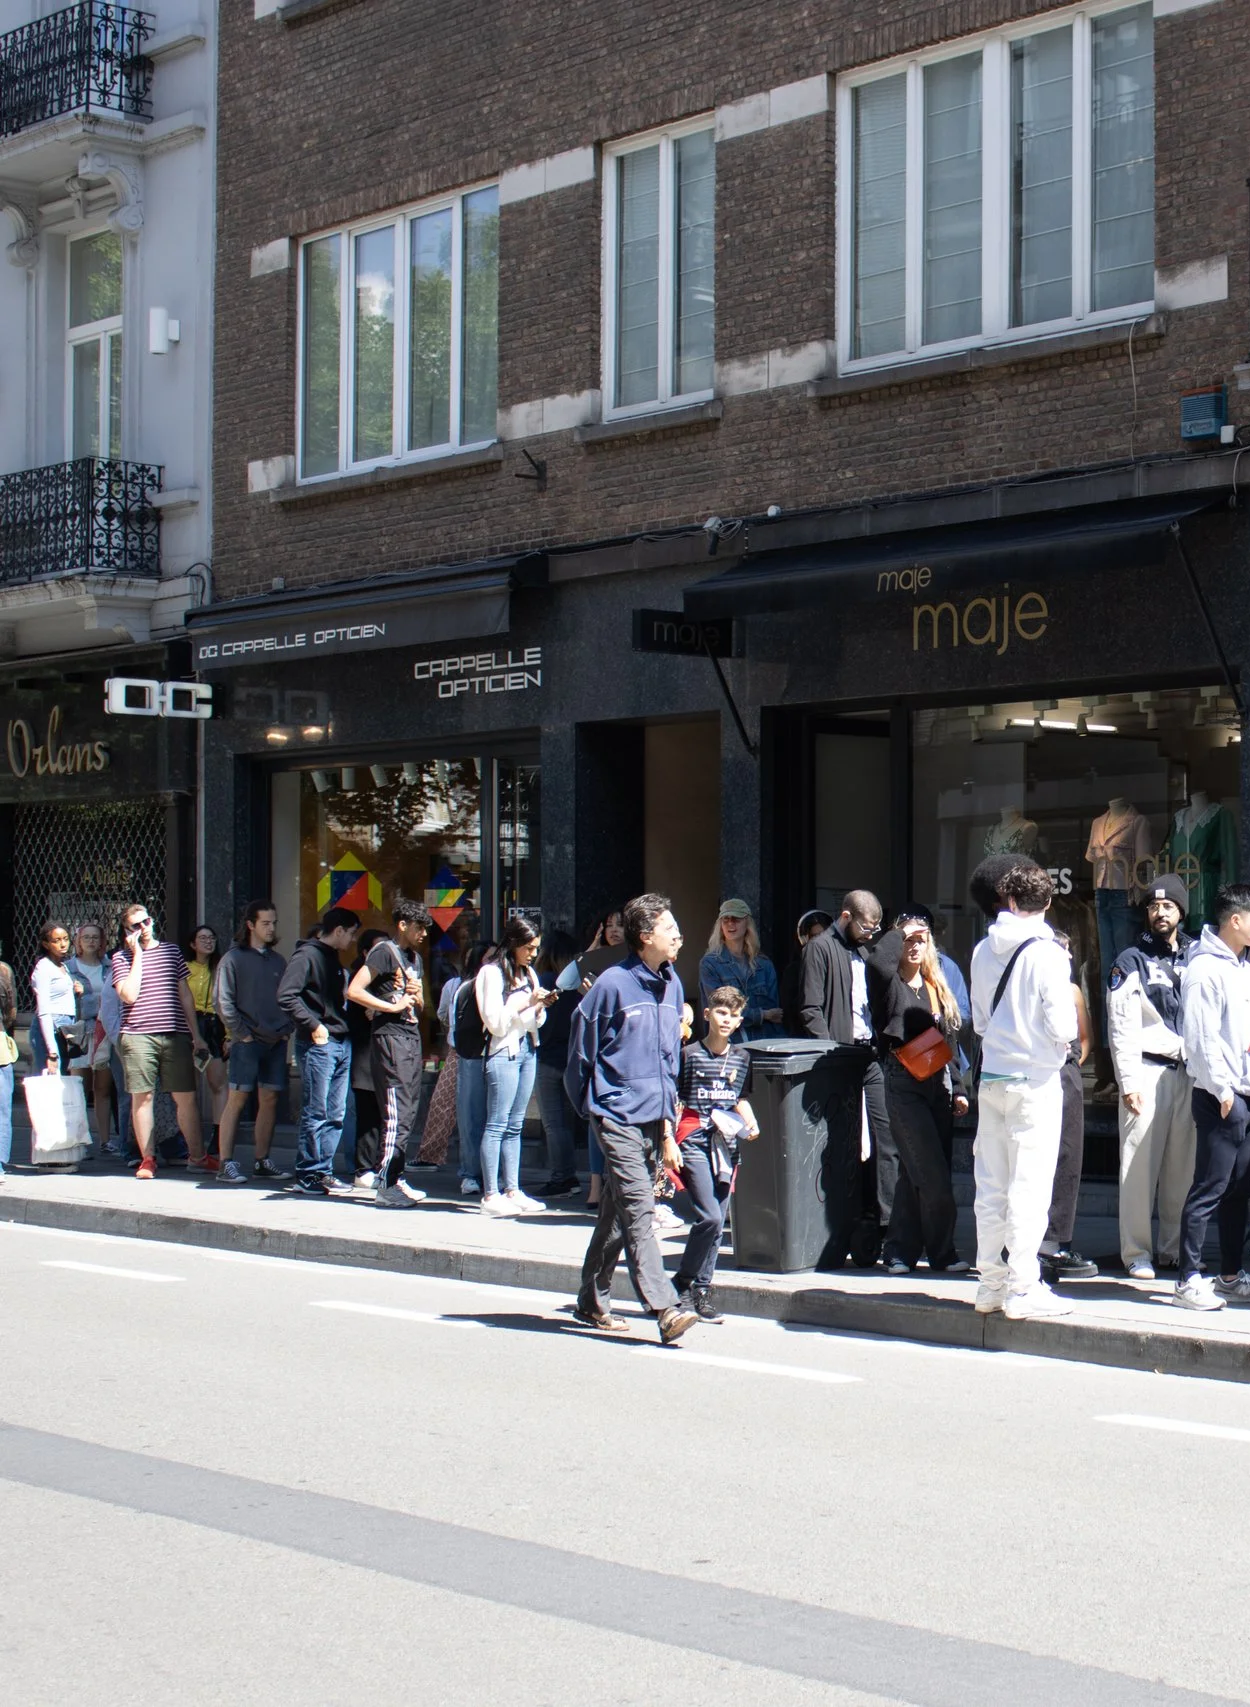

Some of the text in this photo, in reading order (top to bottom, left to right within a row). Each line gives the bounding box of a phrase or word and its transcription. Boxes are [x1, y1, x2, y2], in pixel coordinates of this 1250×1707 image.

[877, 563, 932, 595] maje
[913, 583, 1049, 656] maje
[221, 633, 307, 656] CAPPELLE
[313, 623, 386, 645] OPTICIEN
[653, 621, 720, 651] maje
[414, 647, 542, 680] CAPPELLE
[438, 669, 542, 698] OPTICIEN
[7, 705, 107, 778] Orlans
[712, 1080, 726, 1089] Fly
